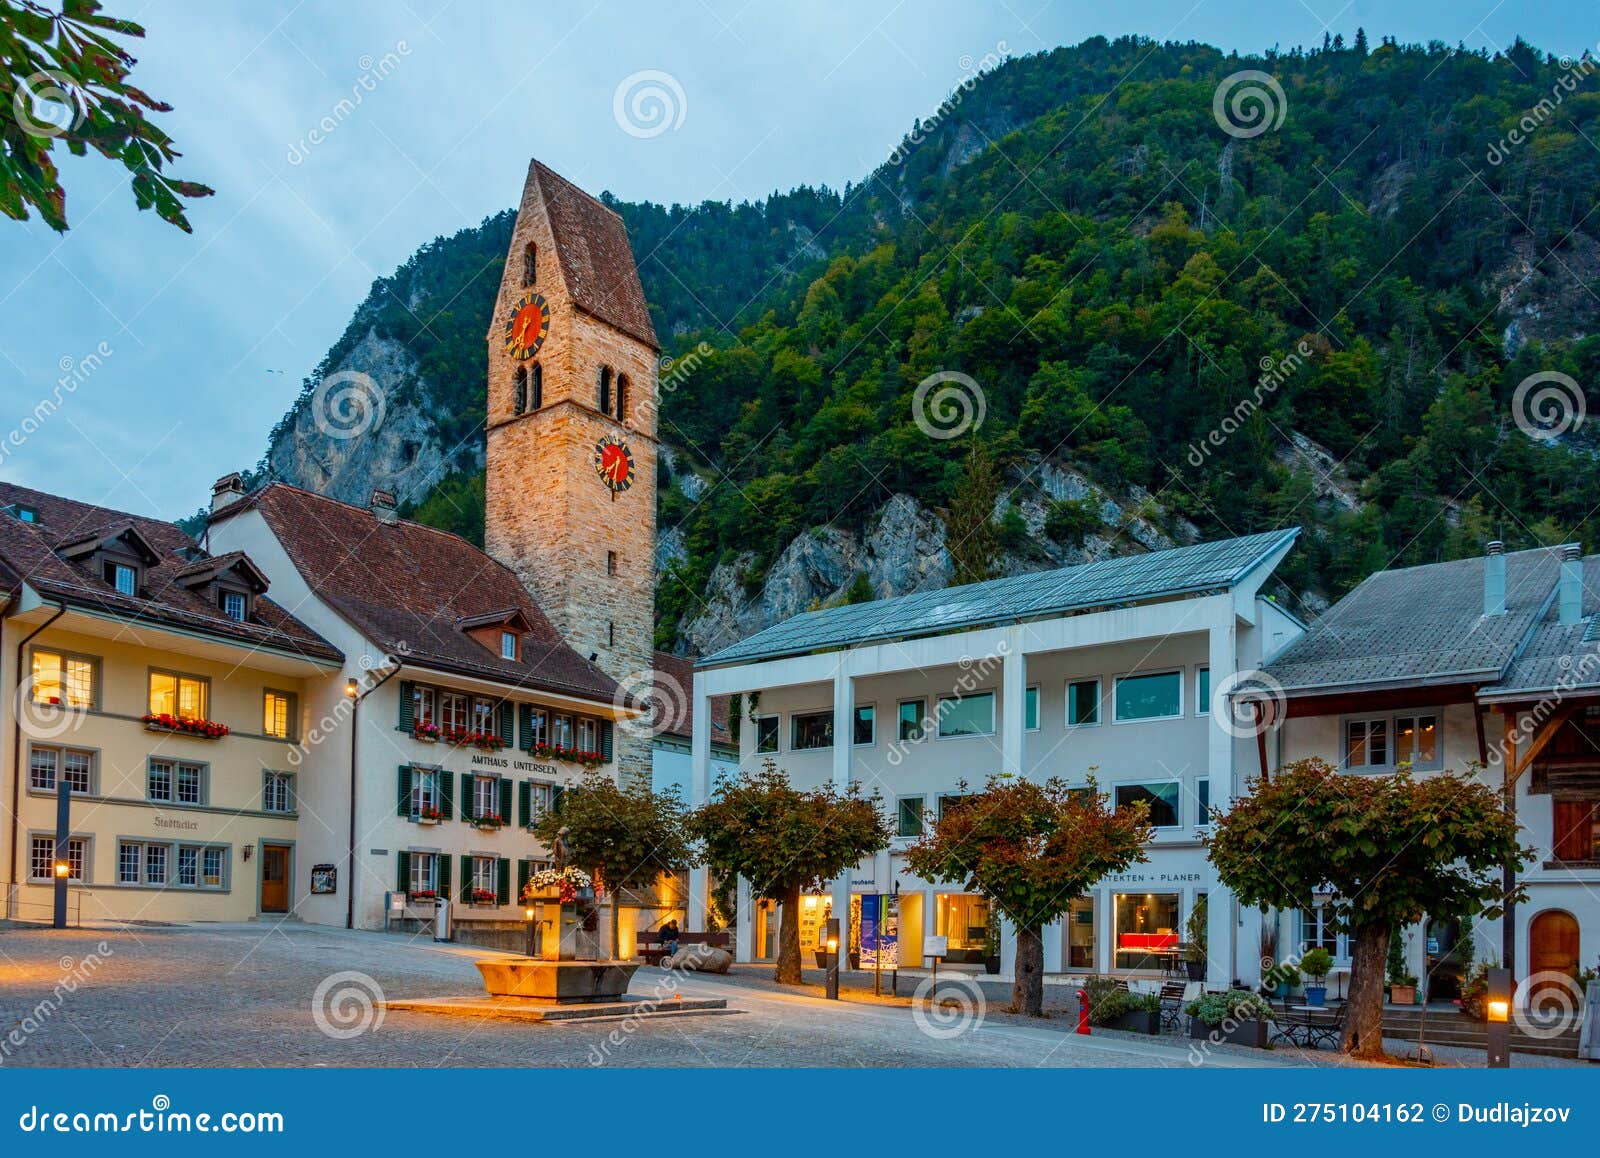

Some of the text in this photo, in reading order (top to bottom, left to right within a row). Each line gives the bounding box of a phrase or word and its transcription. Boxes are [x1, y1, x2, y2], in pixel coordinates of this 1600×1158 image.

[471, 754, 558, 775] AMTHAUS UNTERSEEN
[1160, 873, 1201, 882] PLANER
